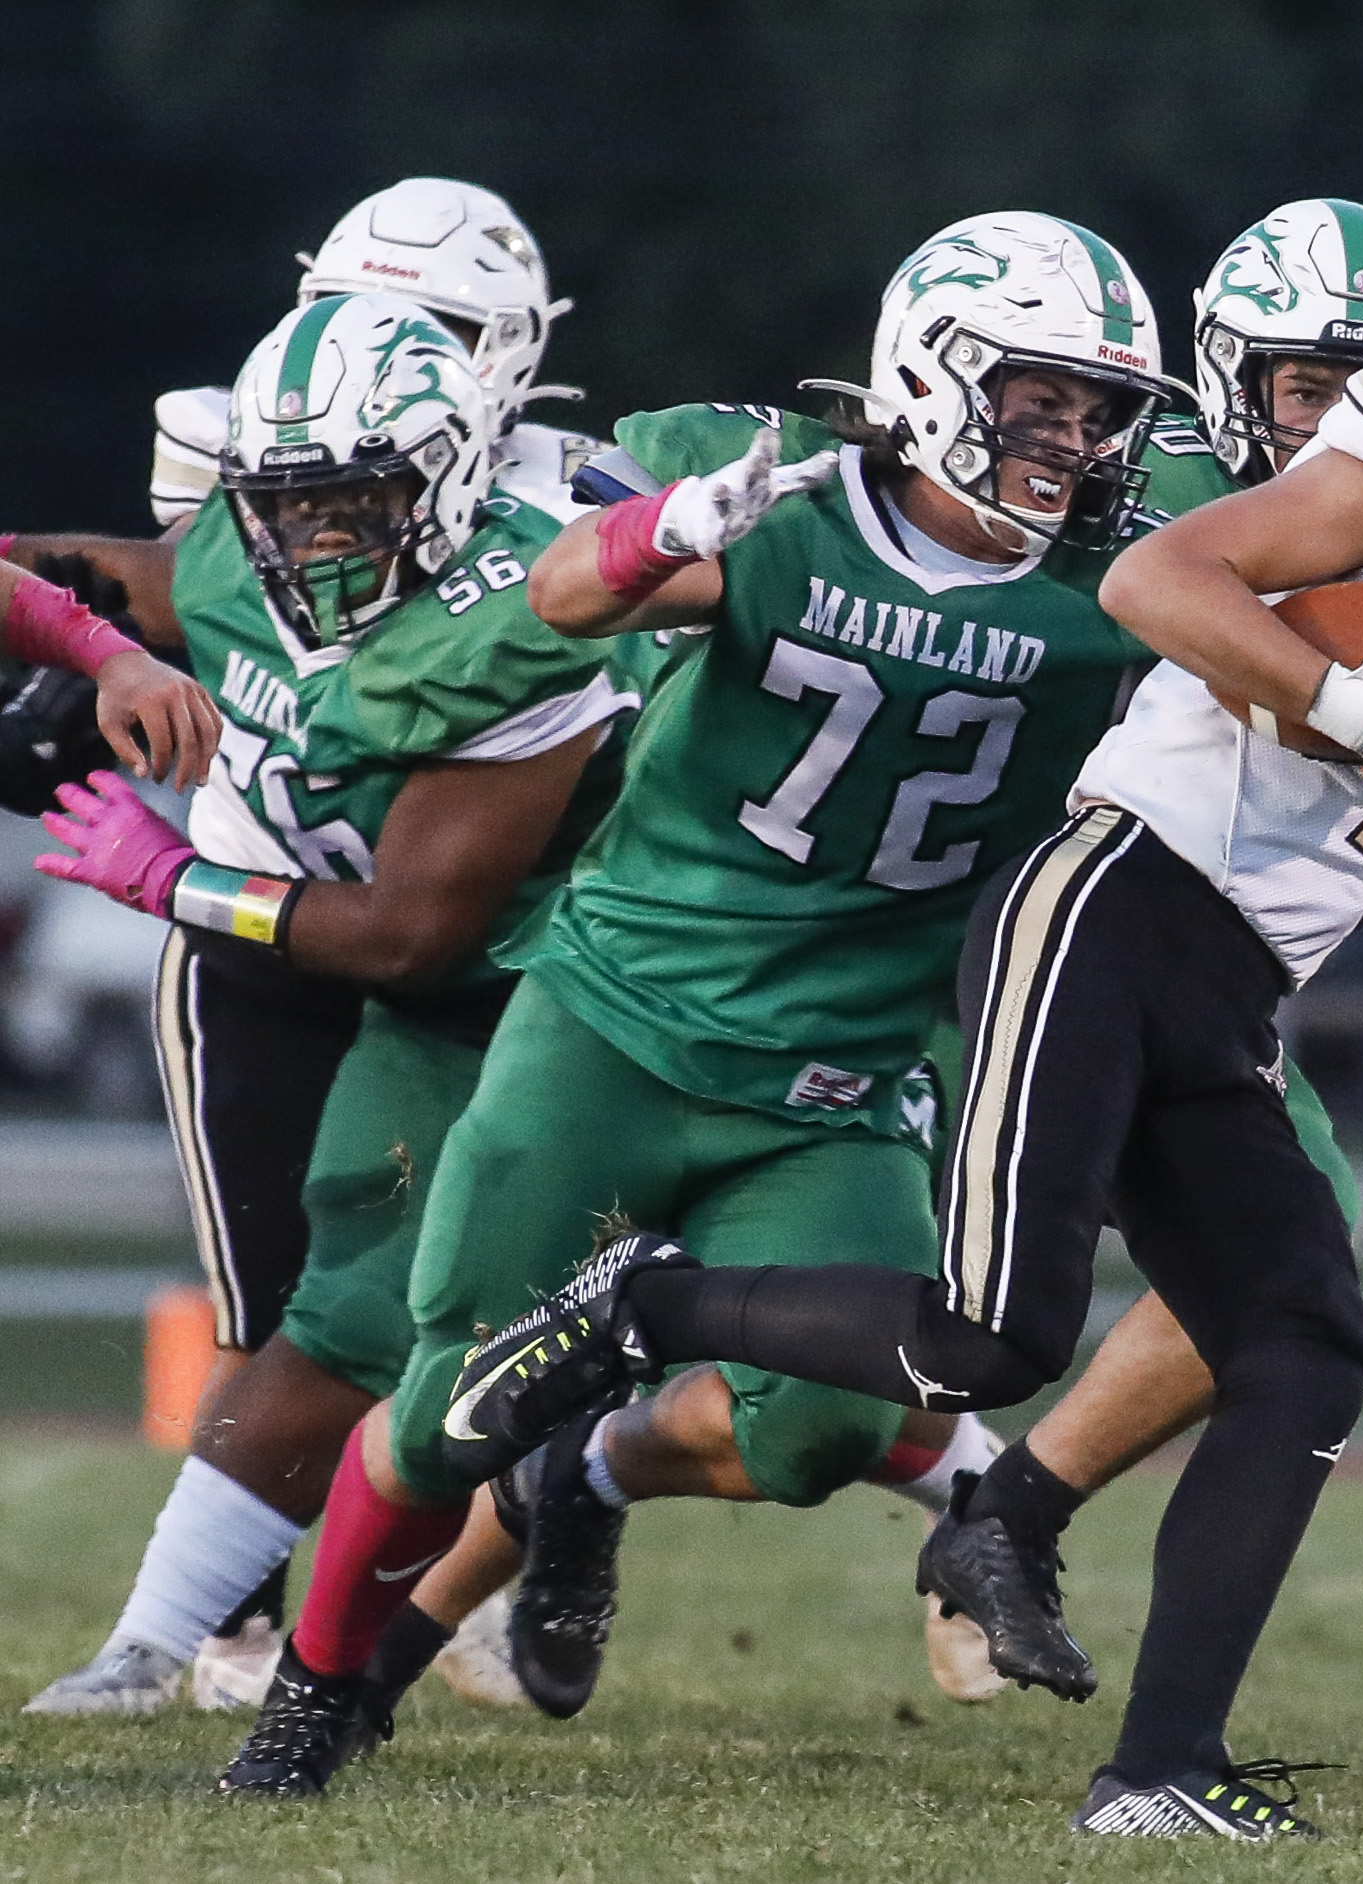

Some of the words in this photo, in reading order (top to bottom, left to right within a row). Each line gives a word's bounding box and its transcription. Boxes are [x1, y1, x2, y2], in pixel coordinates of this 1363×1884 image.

[1098, 345, 1148, 370] Riddell
[436, 548, 528, 616] 56
[799, 576, 1046, 684] MAINLAND
[737, 637, 1027, 891] 72
